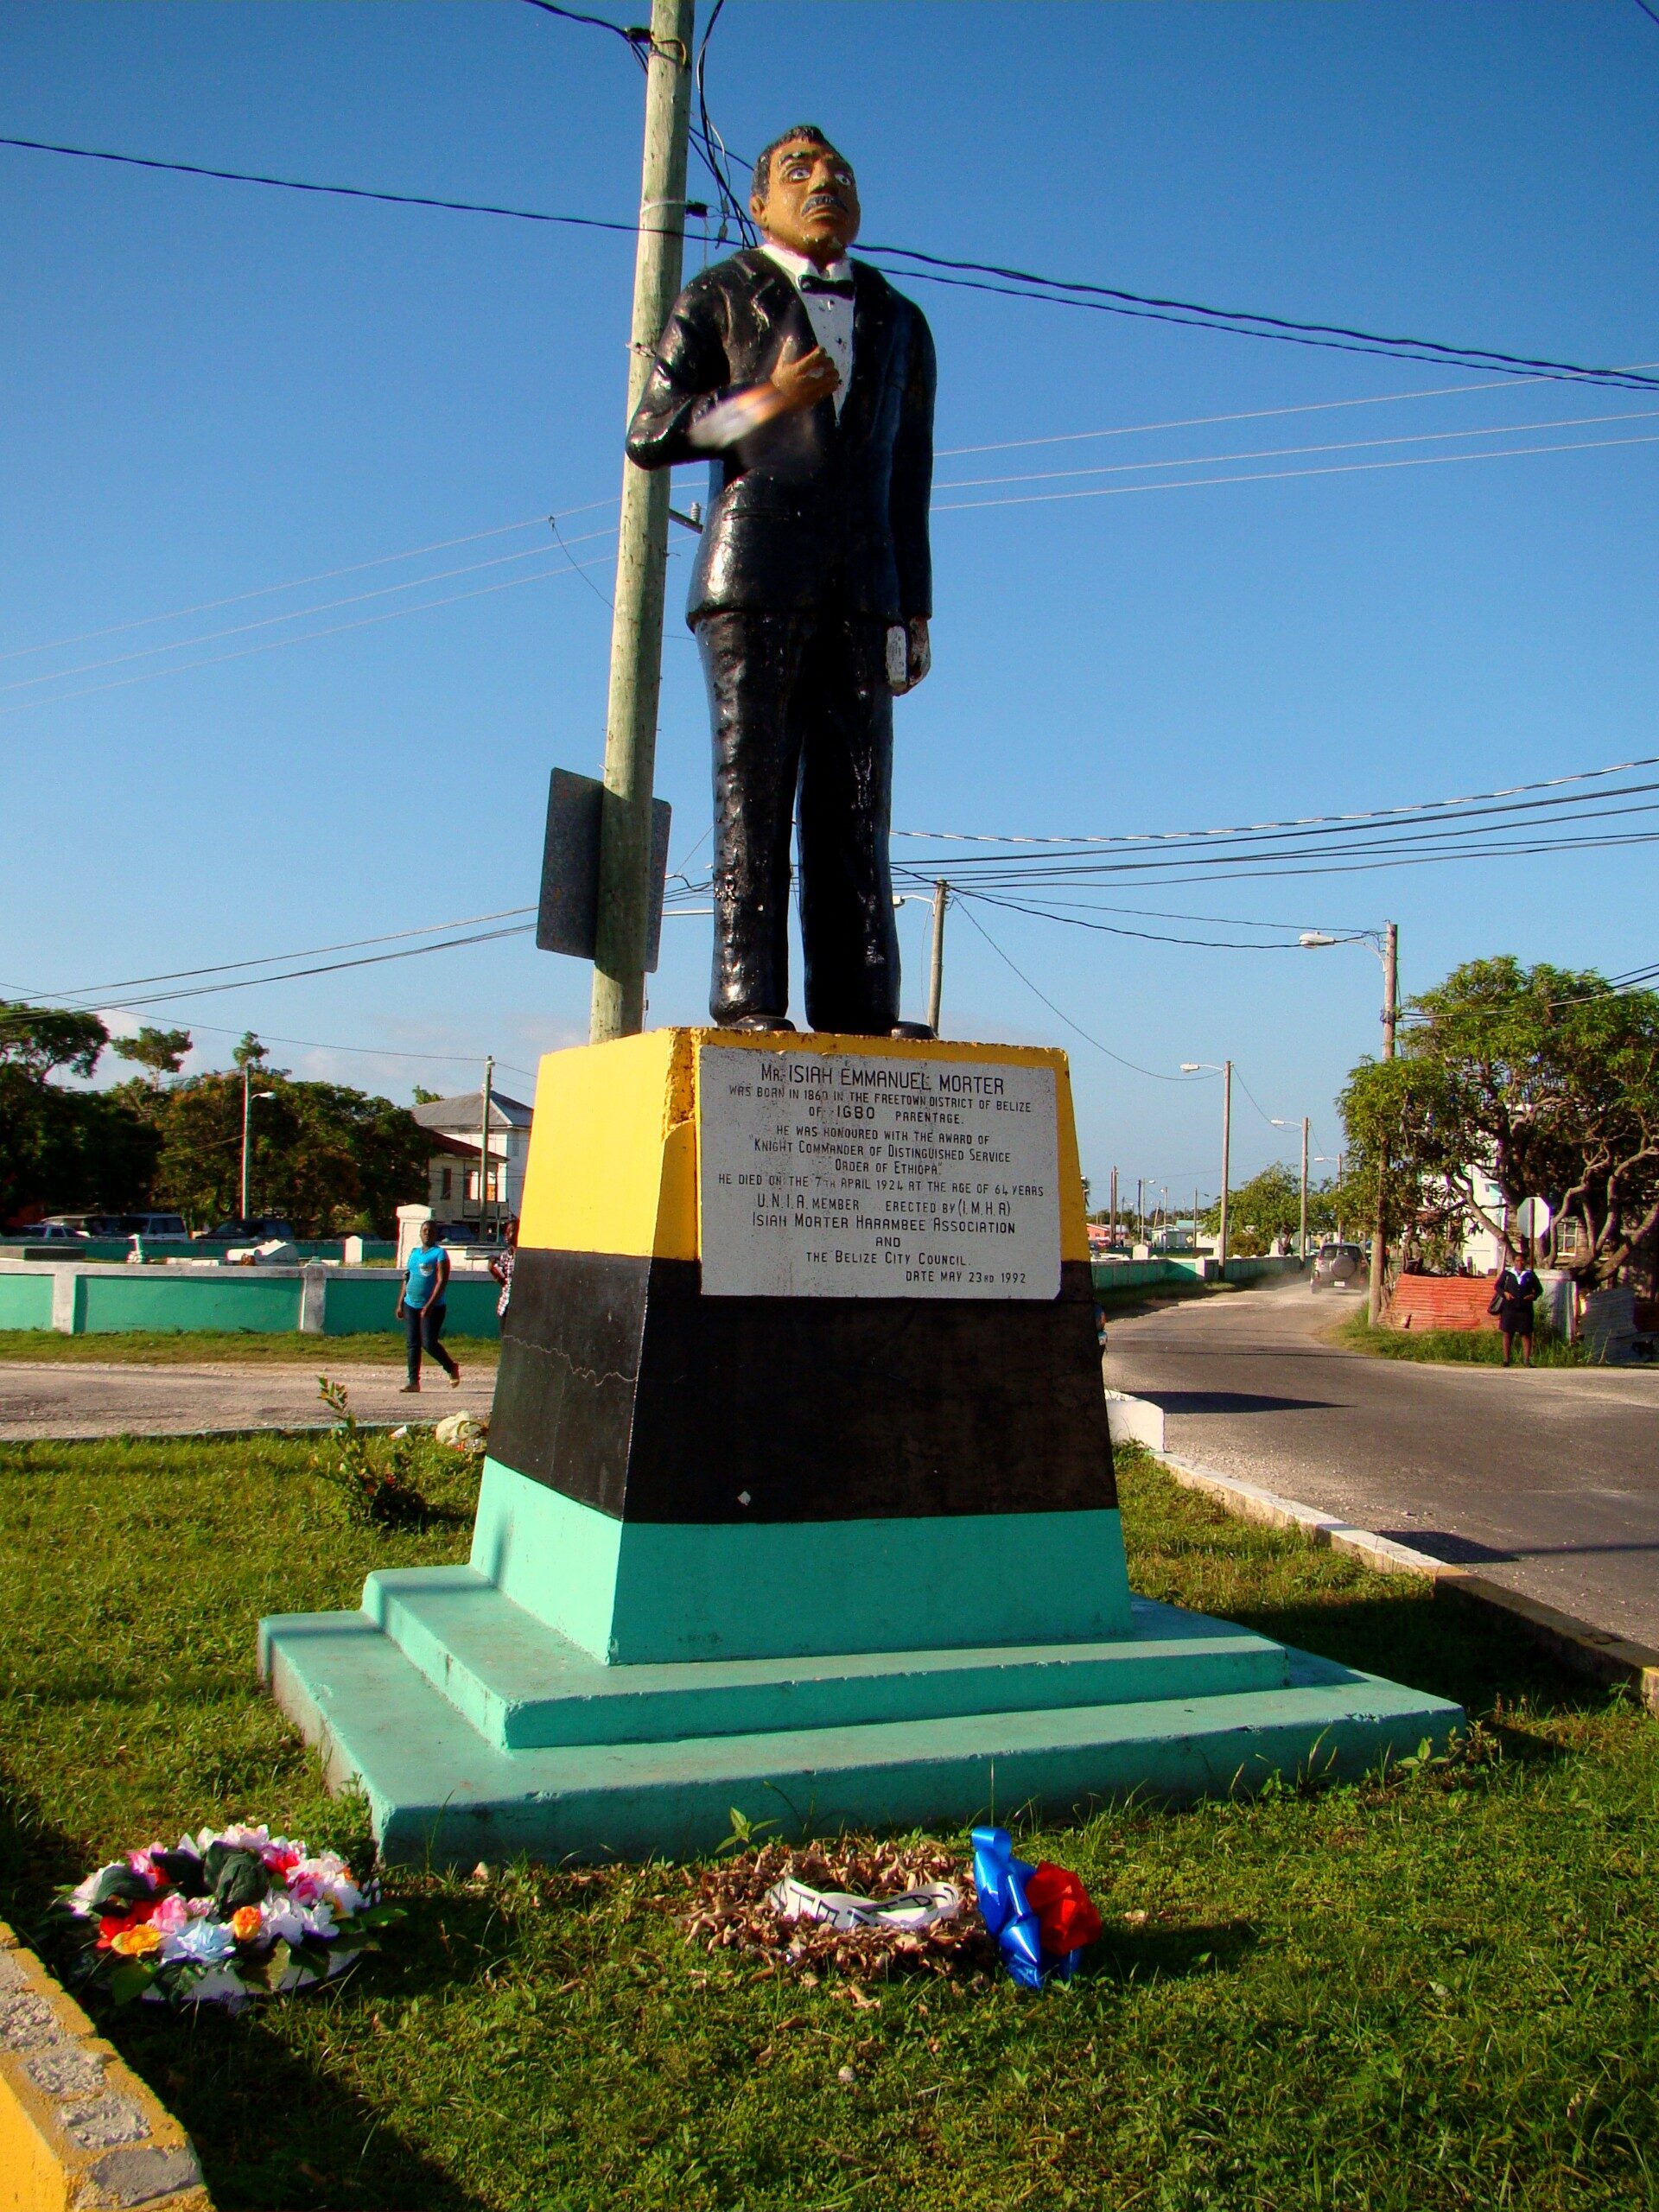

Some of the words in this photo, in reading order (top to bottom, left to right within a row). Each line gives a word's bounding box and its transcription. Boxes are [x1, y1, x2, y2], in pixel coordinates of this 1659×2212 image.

[789, 1065, 832, 1084] ISIAH
[841, 1068, 931, 1091] EMMANUEL
[939, 1074, 1004, 1095] MORTER
[729, 1084, 751, 1096] WAS
[757, 1087, 785, 1098] BORN
[790, 1089, 799, 1099] IN
[834, 1090, 843, 1102] IN
[850, 1092, 868, 1103] THE
[874, 1093, 926, 1106] FREETOWN
[929, 1096, 973, 1109] DISTRICT
[979, 1100, 990, 1110] OF
[996, 1101, 1031, 1113] BELIZE
[809, 1106, 822, 1116] OF
[837, 1105, 875, 1120] IGBO
[895, 1110, 964, 1124] PARENTAGE.
[777, 1125, 789, 1135] HE
[796, 1126, 817, 1137] WAS
[823, 1127, 878, 1140] HONOURED
[884, 1130, 908, 1141] WITH
[915, 1131, 933, 1142] THE
[938, 1133, 972, 1145] AWARD
[978, 1135, 990, 1145] OF
[798, 1140, 864, 1156] COMMANDER
[869, 1147, 882, 1157] OF
[888, 1145, 964, 1161] DISTINGUISHED
[969, 1148, 1011, 1163] SERVICE
[835, 1159, 869, 1173] ORDER
[875, 1162, 887, 1173] OF
[719, 1173, 732, 1185] HE
[738, 1174, 762, 1185] DIED
[769, 1175, 782, 1186] ON
[790, 1176, 809, 1187] THE
[841, 1178, 871, 1190] APRIL
[876, 1179, 903, 1192] 1924
[908, 1180, 920, 1192] AT
[928, 1181, 946, 1192] THE
[951, 1182, 971, 1193] AGE
[976, 1184, 989, 1194] OF
[995, 1184, 1008, 1196] 64
[1012, 1185, 1044, 1197] YEARS
[812, 1198, 859, 1211] MEMBER
[886, 1200, 936, 1213] ERECTED
[942, 1203, 955, 1214] BY
[753, 1212, 787, 1227] ISIAH
[795, 1213, 849, 1229] MORTER
[856, 1215, 925, 1231] HARAMBEE
[933, 1217, 1015, 1234] ASSOCIATION
[875, 1236, 900, 1248] AND
[806, 1252, 828, 1262] THE
[835, 1250, 877, 1263] BELIZE
[885, 1251, 911, 1264] CITY
[918, 1253, 971, 1266] COUNCIL.
[906, 1270, 934, 1282] DATE
[940, 1271, 962, 1282] MAY
[969, 1272, 994, 1283] 23RD
[1001, 1273, 1027, 1284] 1992
